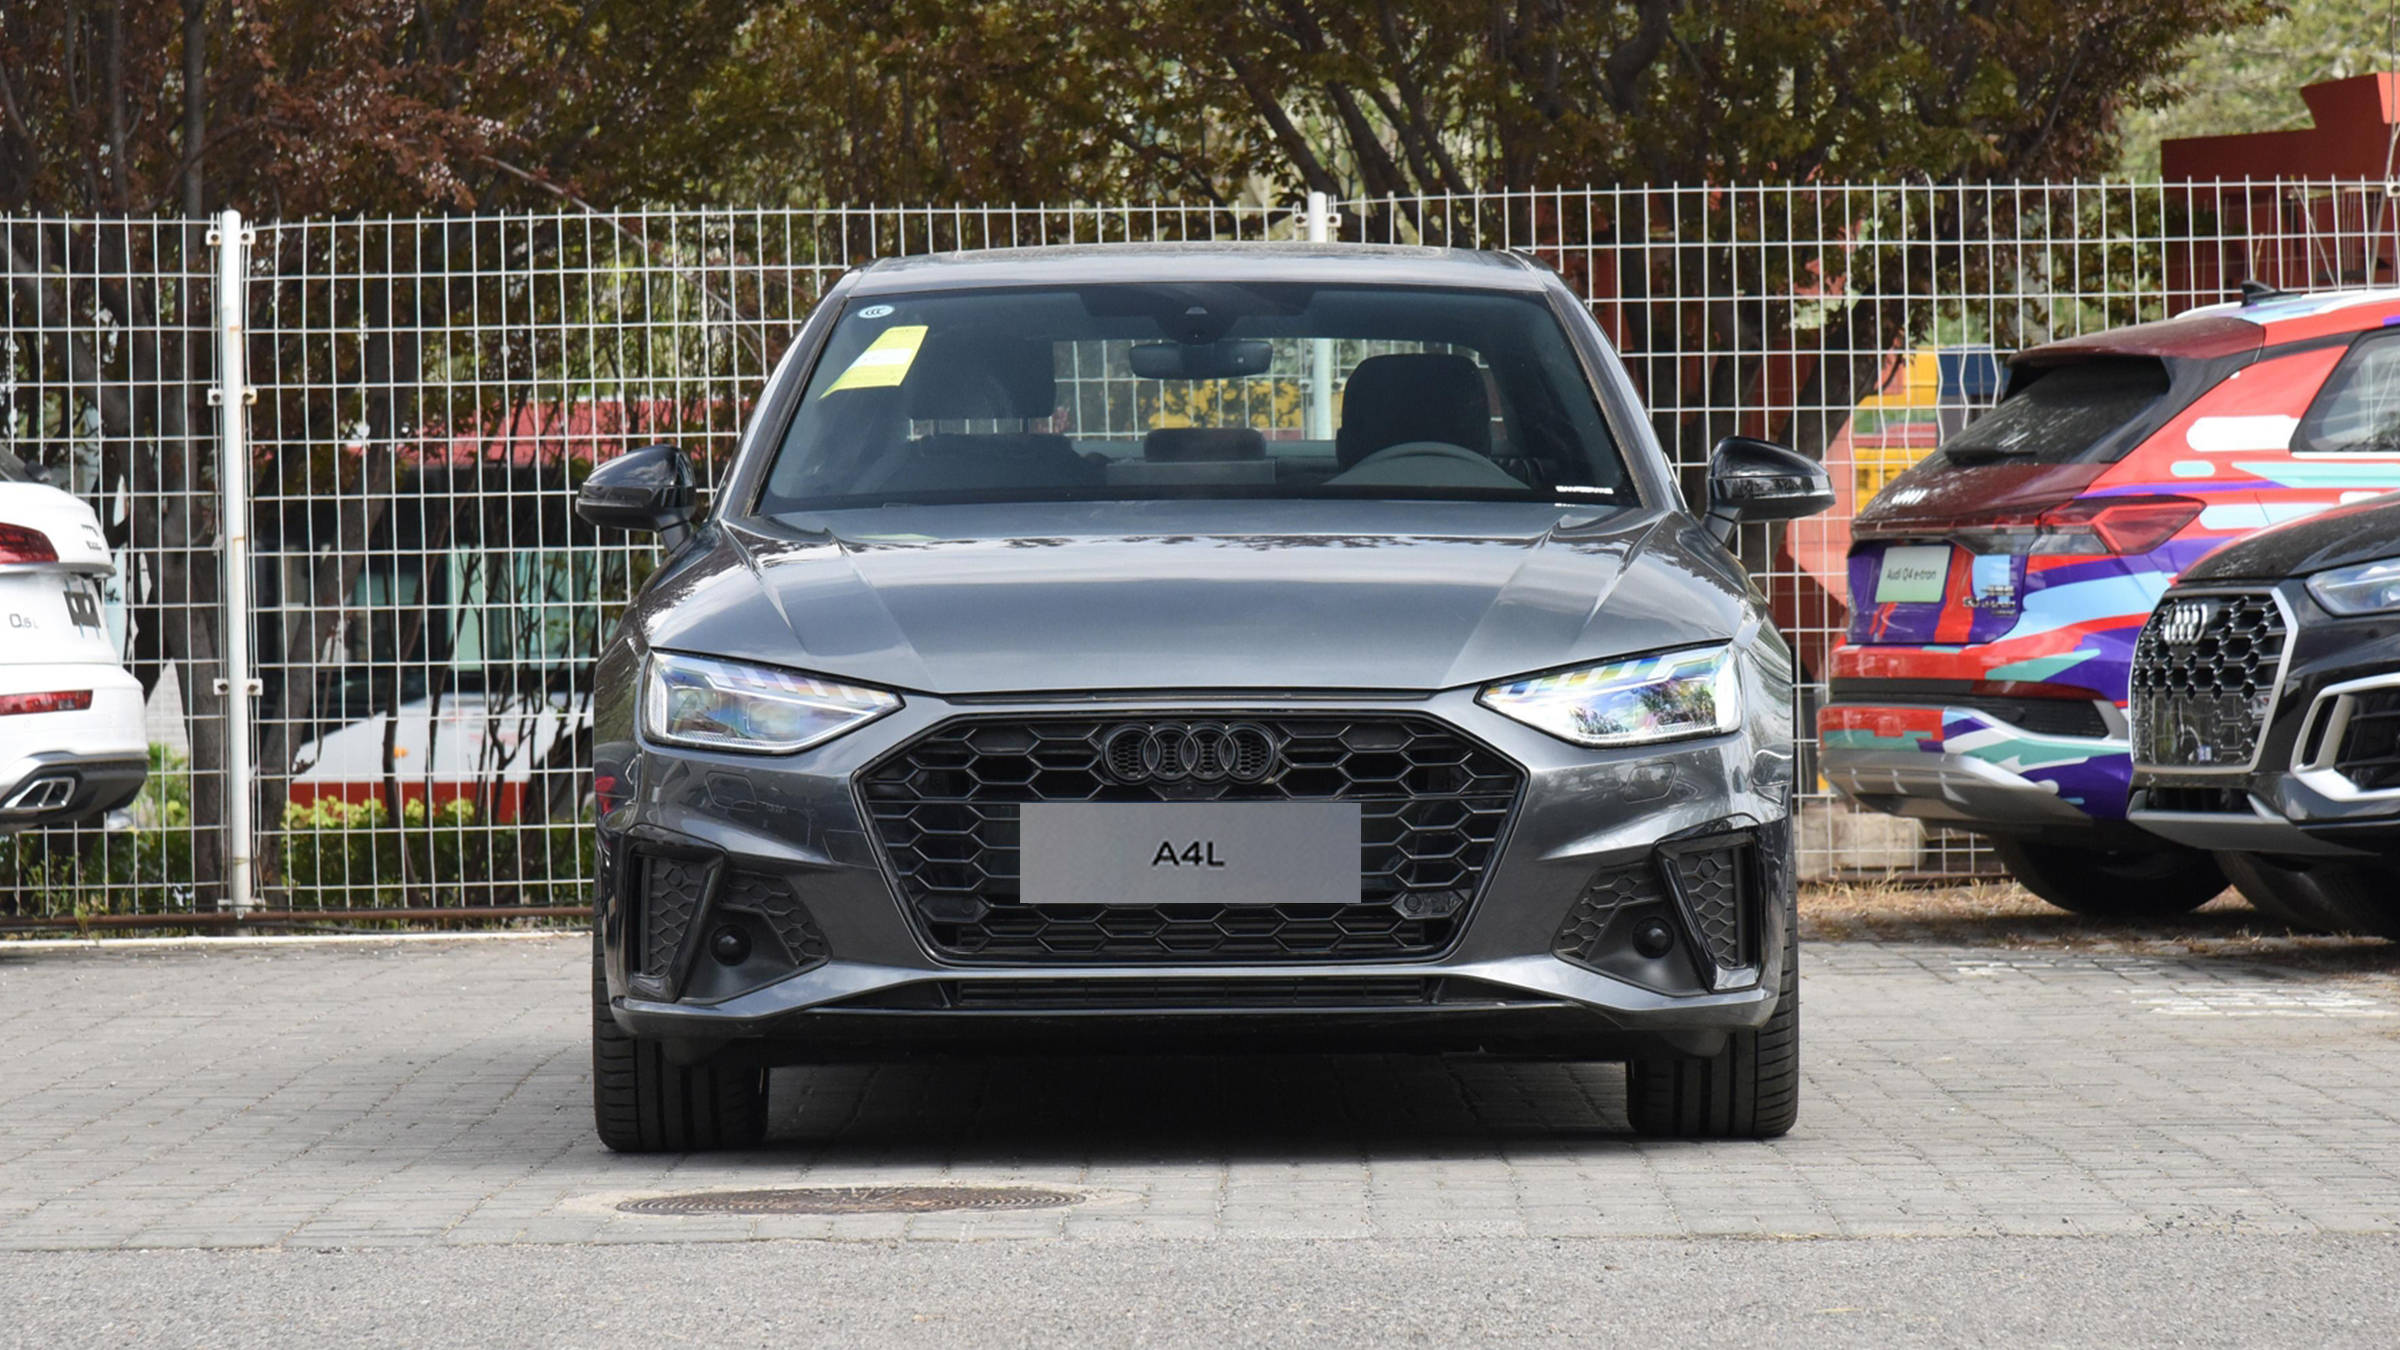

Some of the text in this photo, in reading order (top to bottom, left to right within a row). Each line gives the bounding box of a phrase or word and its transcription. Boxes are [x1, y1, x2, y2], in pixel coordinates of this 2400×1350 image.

[1886, 567, 1901, 580] Audi
[1902, 567, 1914, 582] Q4
[1152, 841, 1225, 867] A4L
